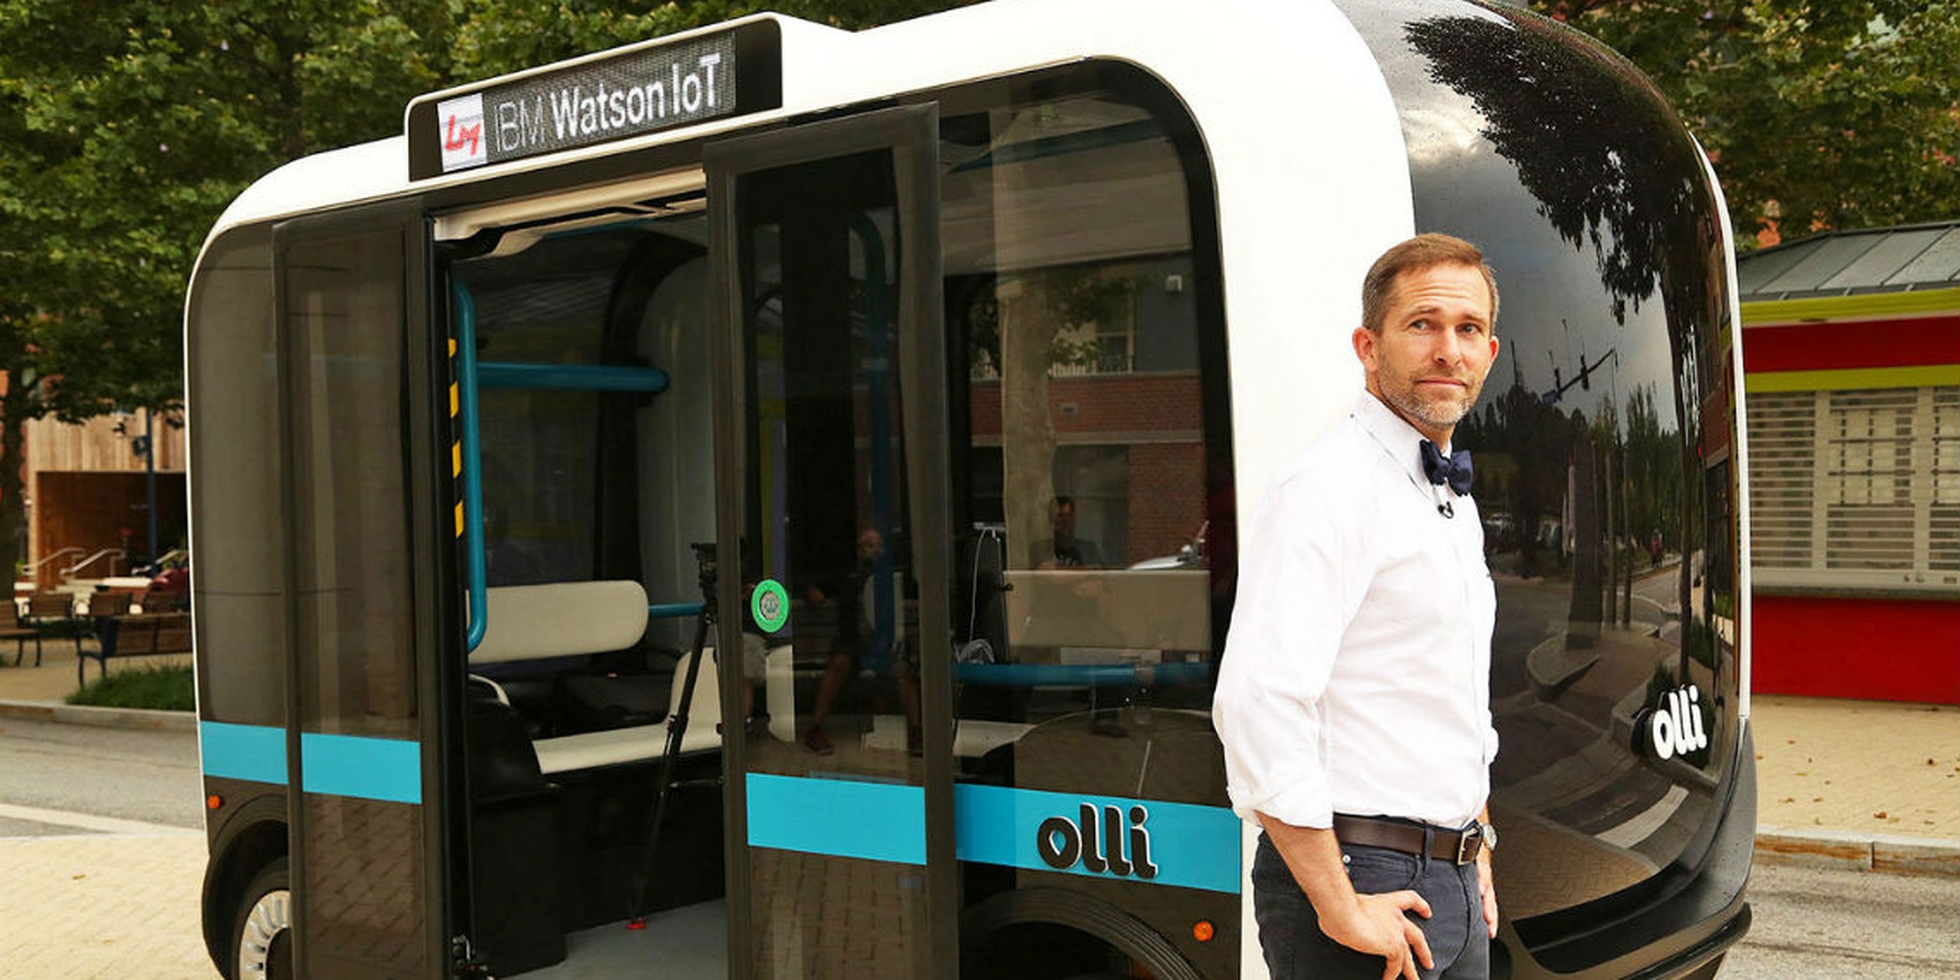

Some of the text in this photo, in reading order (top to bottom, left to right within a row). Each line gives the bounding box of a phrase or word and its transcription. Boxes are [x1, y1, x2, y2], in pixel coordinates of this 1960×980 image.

[495, 53, 721, 152] IBM Watson IoT
[1653, 684, 1707, 760] olli
[1037, 802, 1158, 880] olli
